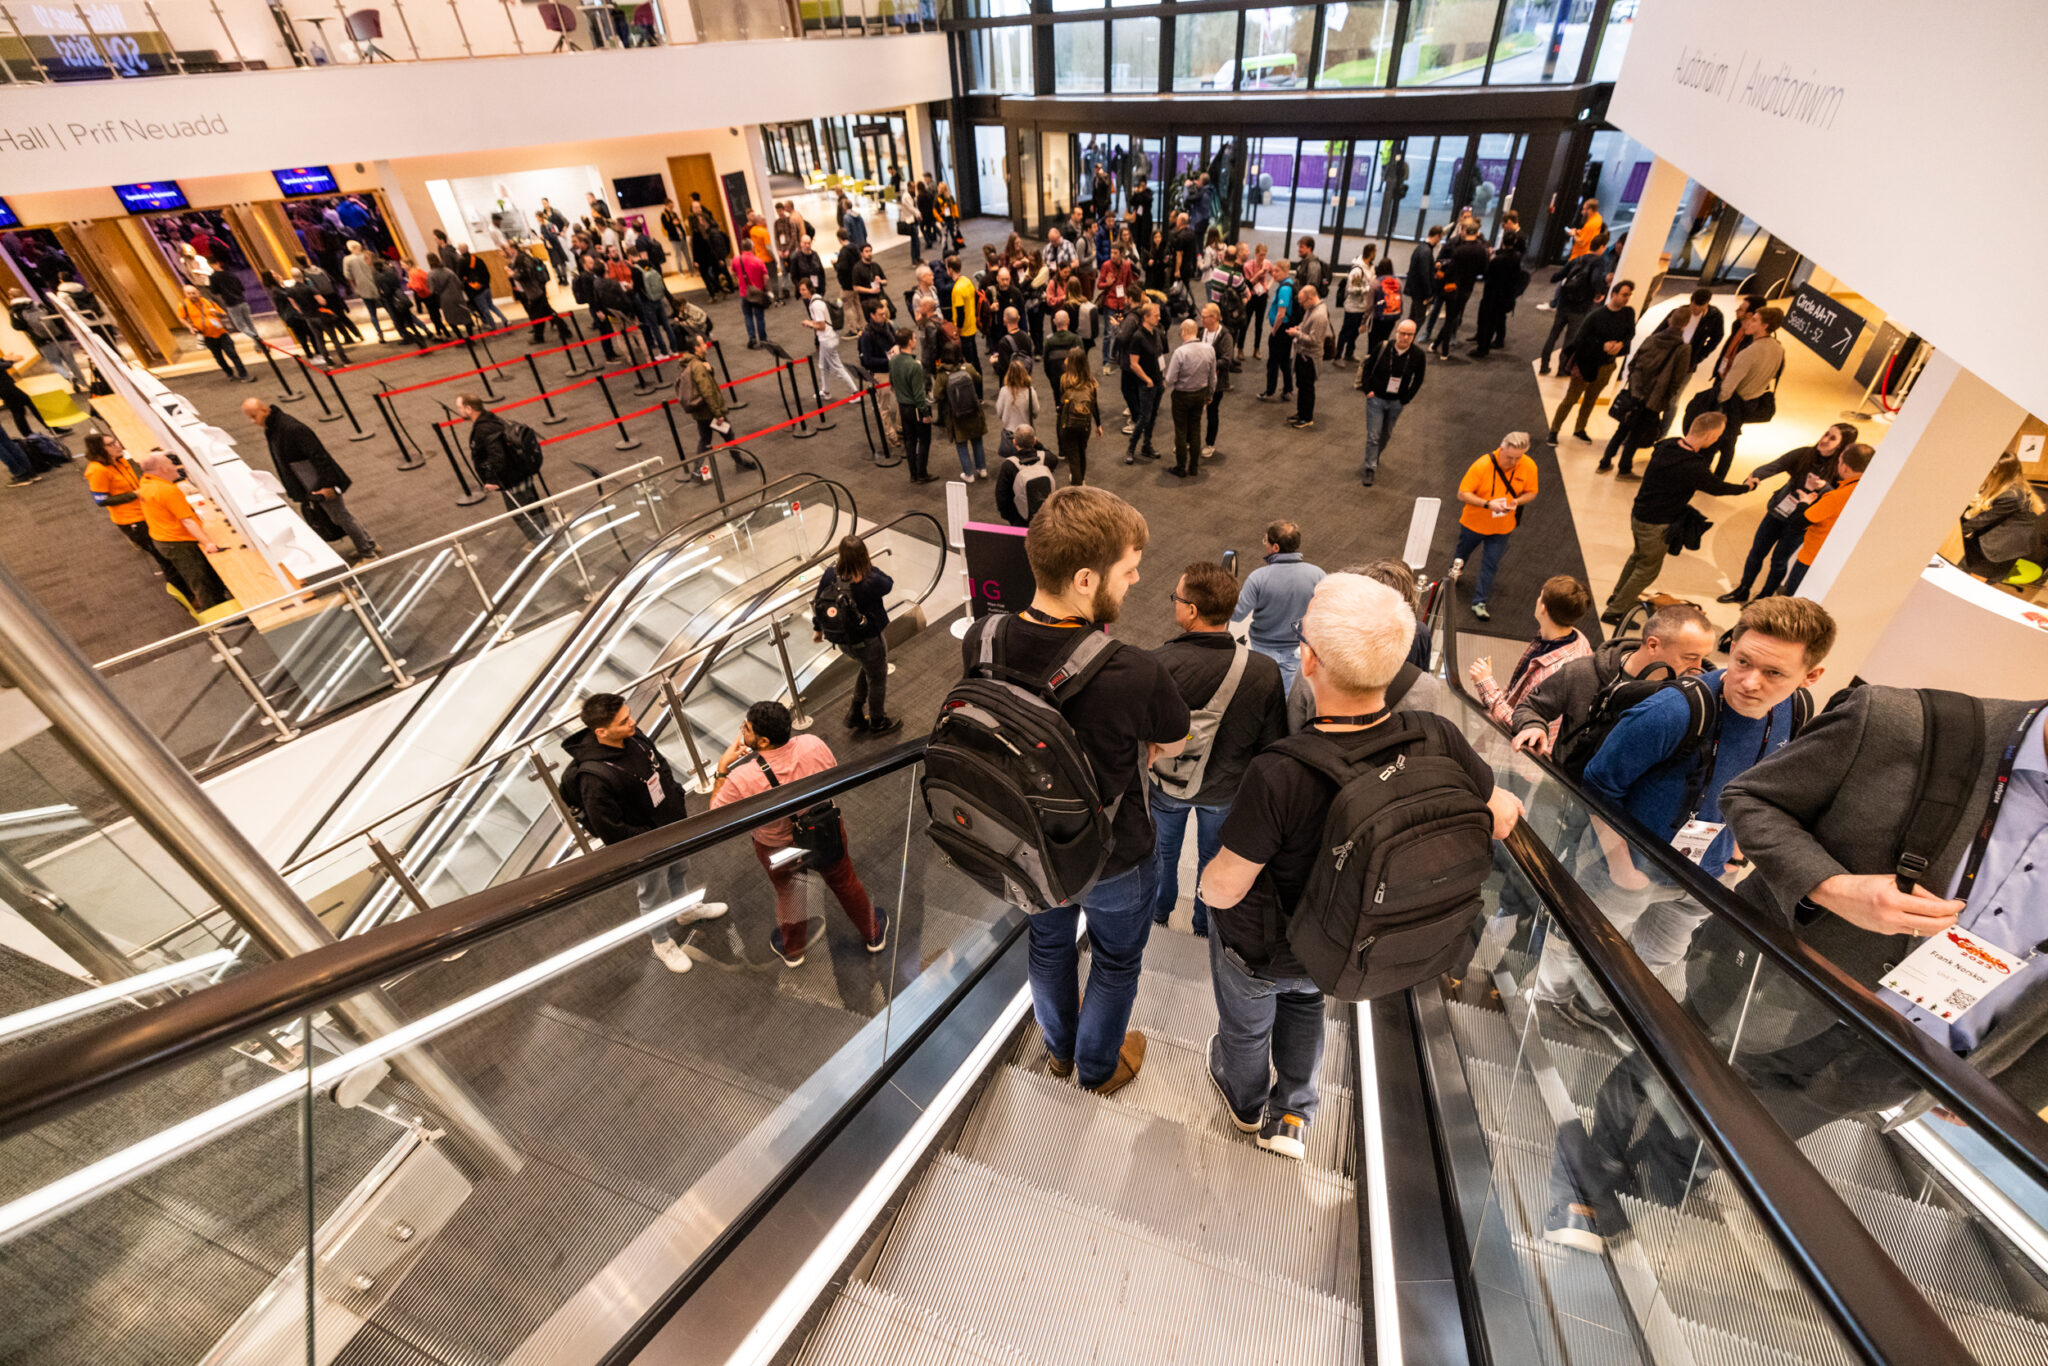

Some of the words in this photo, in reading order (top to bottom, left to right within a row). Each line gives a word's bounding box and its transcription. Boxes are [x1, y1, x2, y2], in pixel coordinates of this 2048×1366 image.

[0, 127, 50, 152] Hall
[67, 120, 118, 146] Prif
[121, 113, 228, 144] Neuadd
[982, 580, 1001, 600] G
[1930, 950, 1953, 966] Frank
